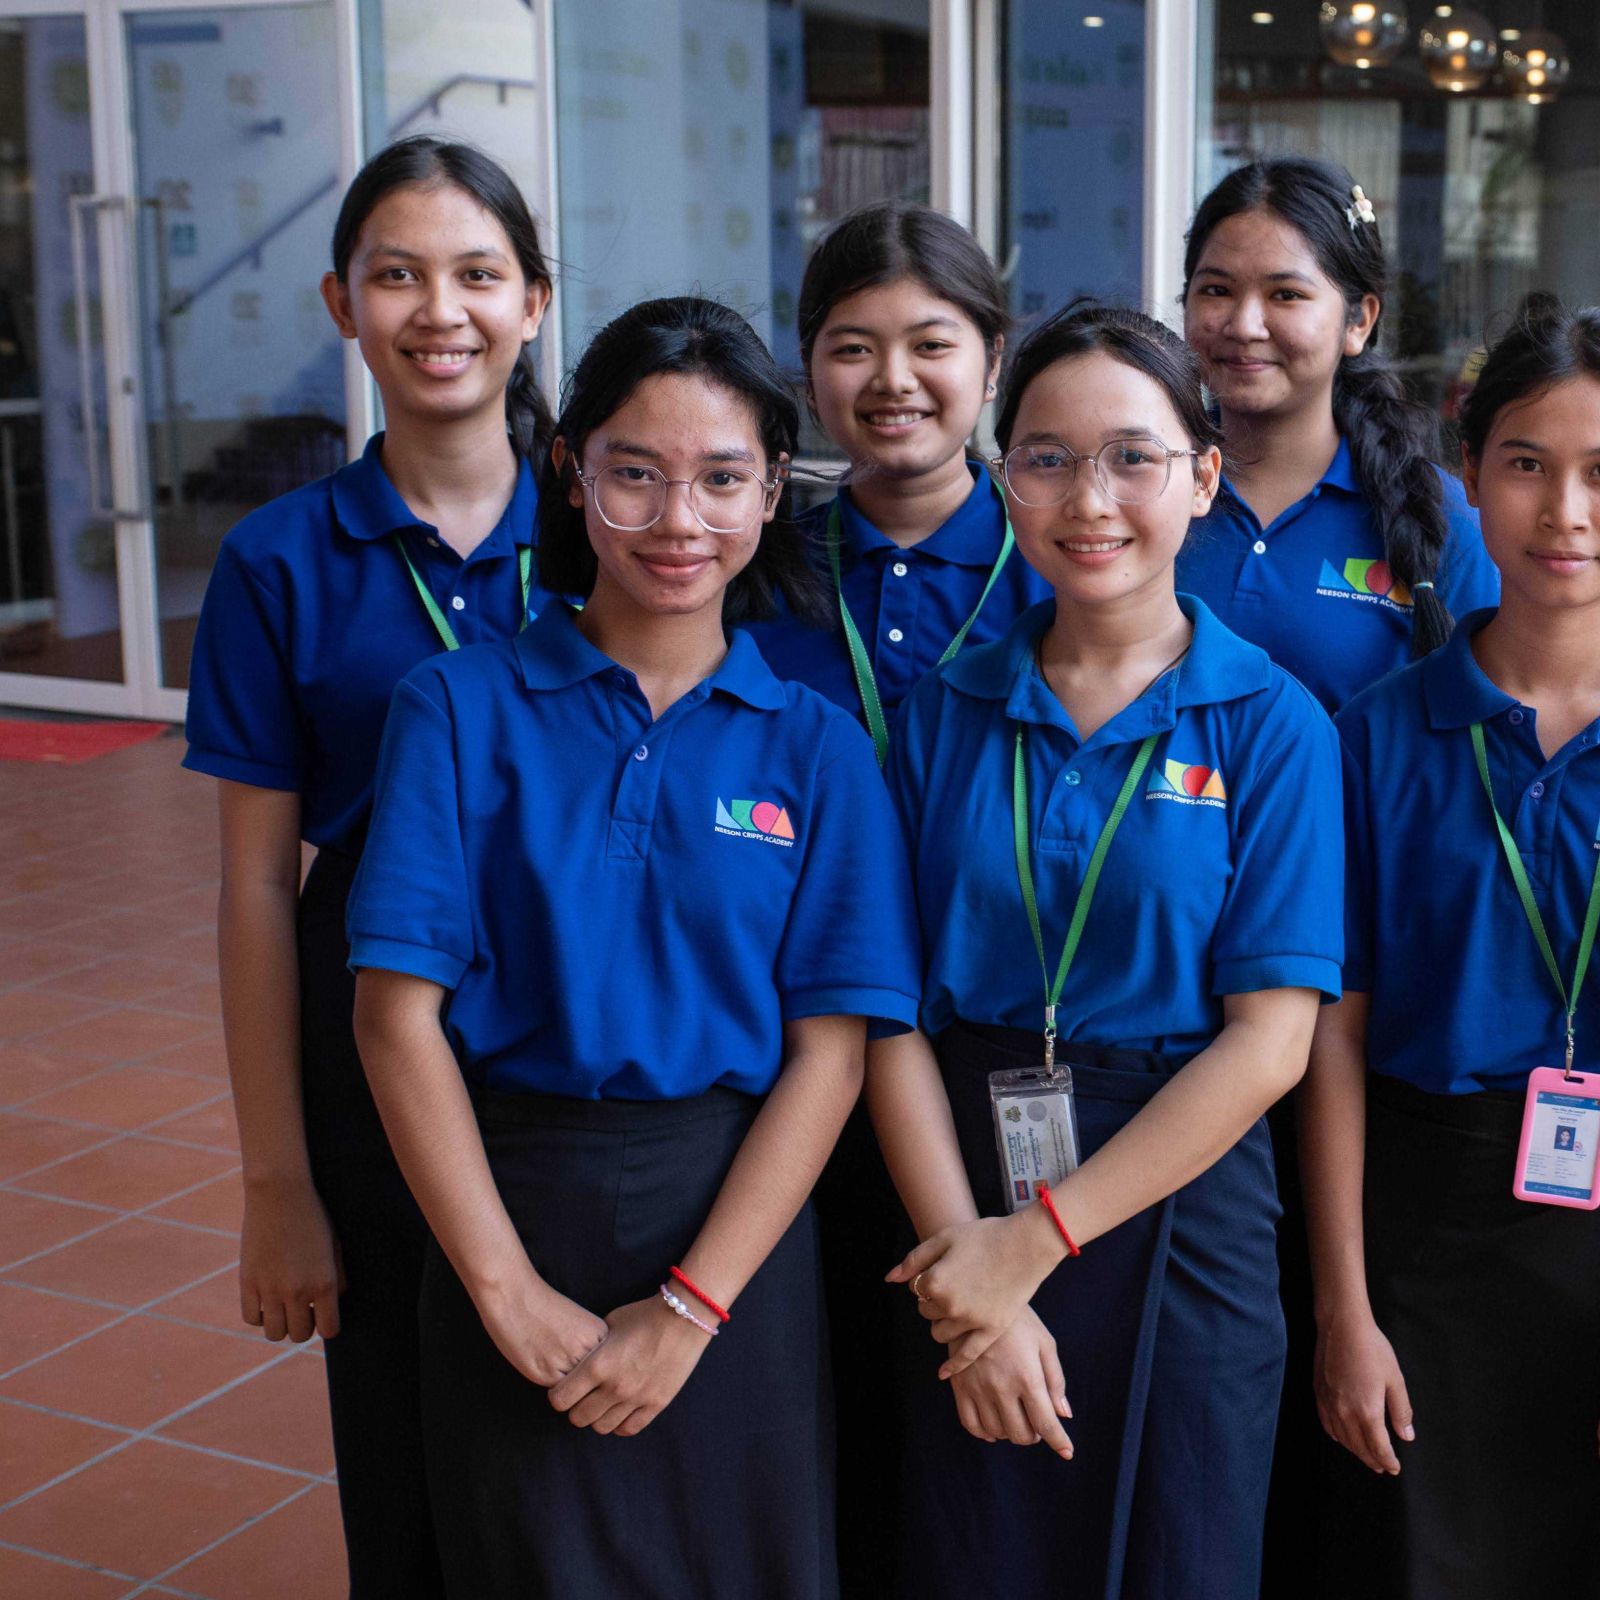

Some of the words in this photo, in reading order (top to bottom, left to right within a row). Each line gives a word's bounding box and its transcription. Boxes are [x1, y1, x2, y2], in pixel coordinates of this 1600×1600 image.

[1316, 588, 1350, 599] NEESON
[1351, 593, 1378, 604] CRIPPS
[1173, 795, 1196, 805] CRIPPS
[1195, 798, 1226, 810] ACADEM
[714, 826, 741, 837] NEESON
[742, 831, 764, 841] CRIPPS
[764, 836, 794, 848] ACADEMY
